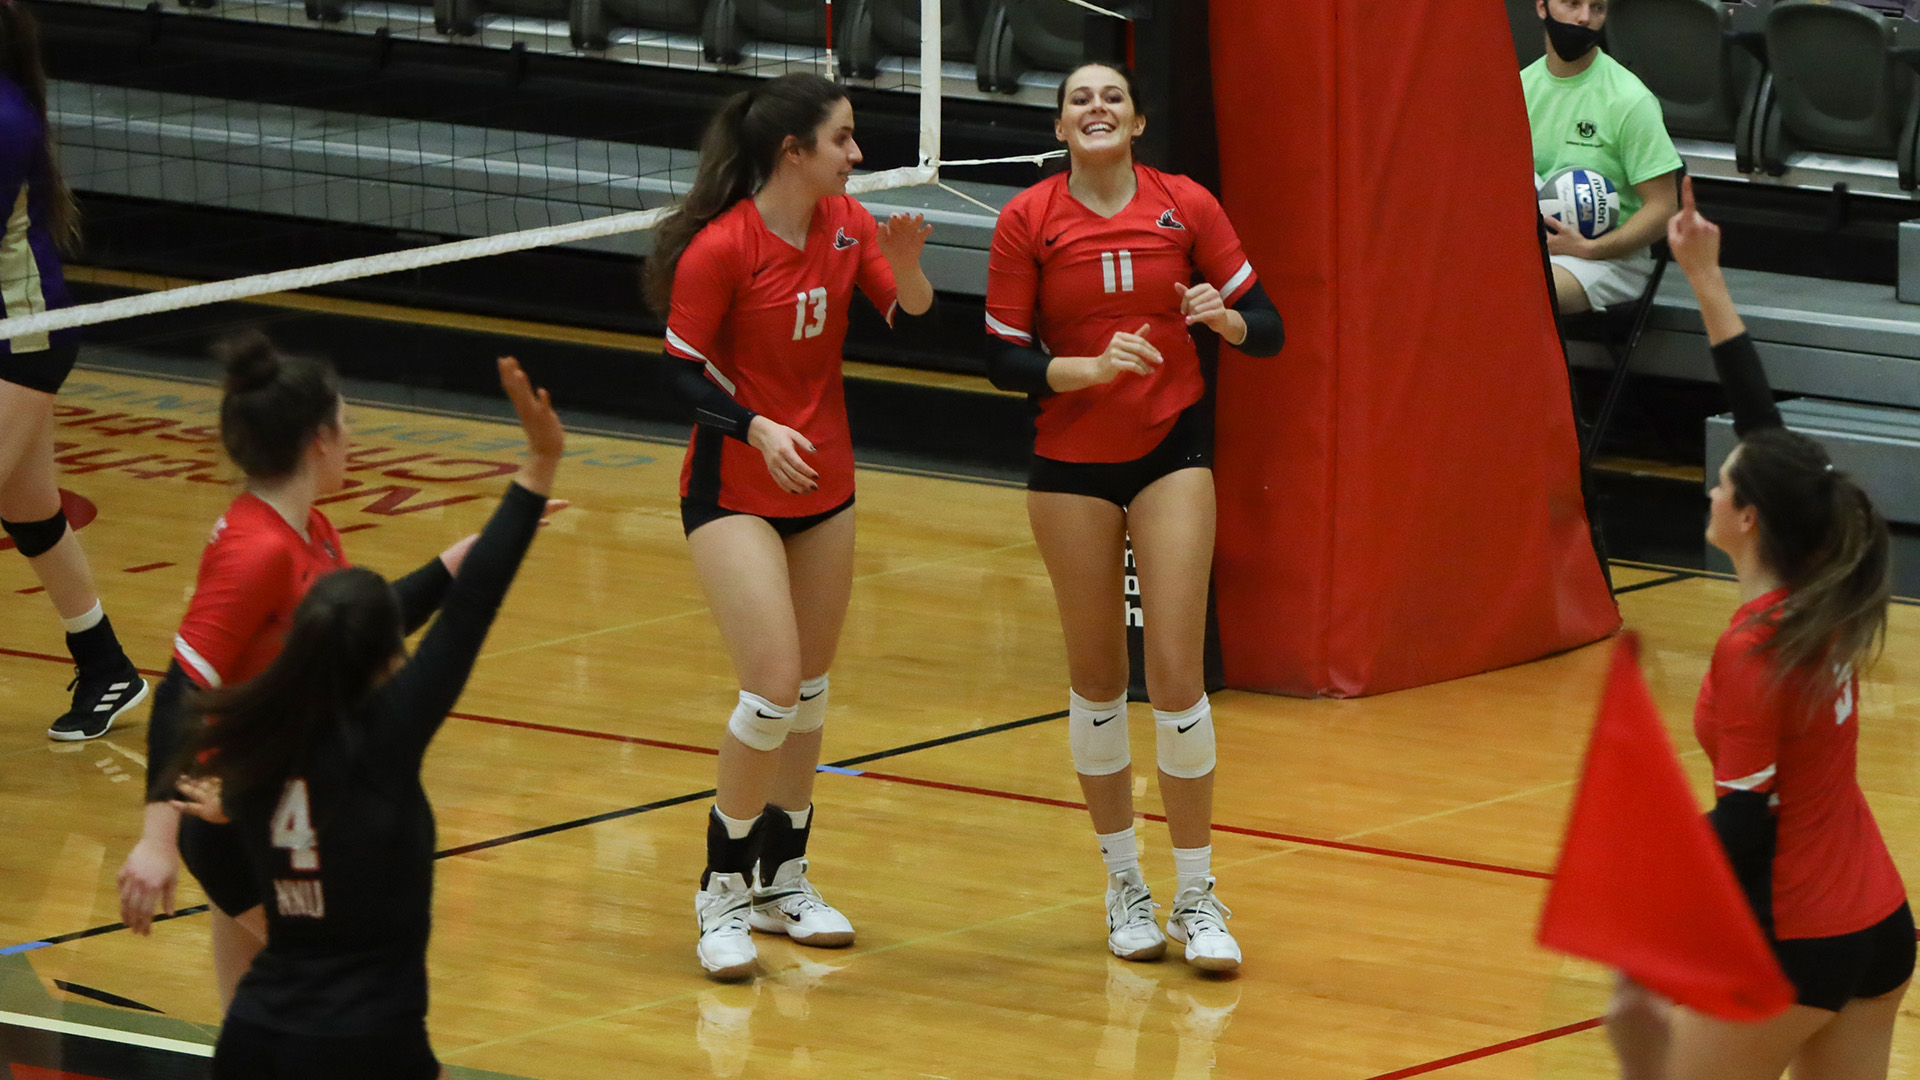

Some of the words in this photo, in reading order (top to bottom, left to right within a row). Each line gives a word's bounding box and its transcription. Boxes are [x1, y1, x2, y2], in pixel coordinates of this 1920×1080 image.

[1575, 184, 1593, 221] NCAA
[1592, 178, 1607, 224] molten
[1101, 249, 1134, 293] 11
[792, 286, 828, 341] 13
[270, 777, 321, 871] 4
